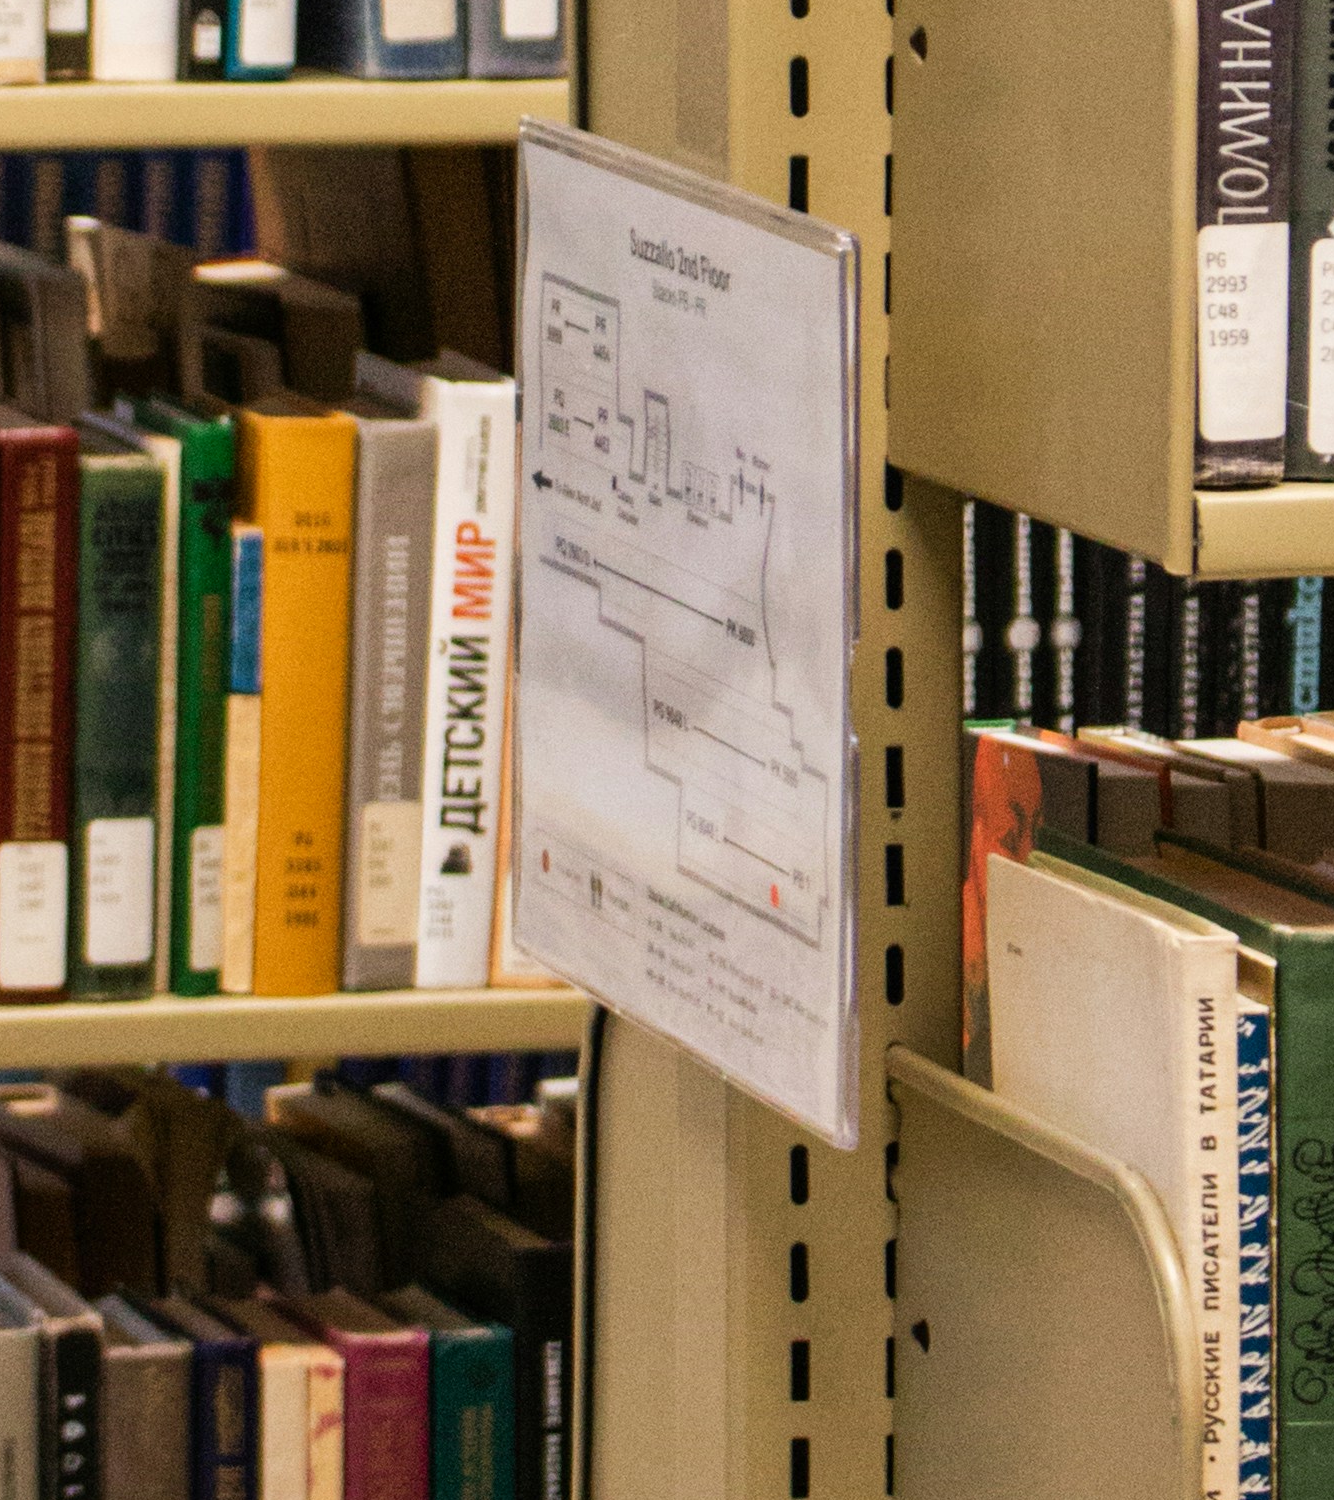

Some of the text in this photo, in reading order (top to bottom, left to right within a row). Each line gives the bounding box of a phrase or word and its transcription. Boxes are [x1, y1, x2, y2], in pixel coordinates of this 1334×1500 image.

[437, 519, 496, 836] ДЕТСКИЙ МИР
[1197, 997, 1217, 1122] ТАТАРИИ
[1201, 1171, 1221, 1313] ПИСАТЕЛИ
[1202, 1329, 1223, 1444] РУССКИЕ
